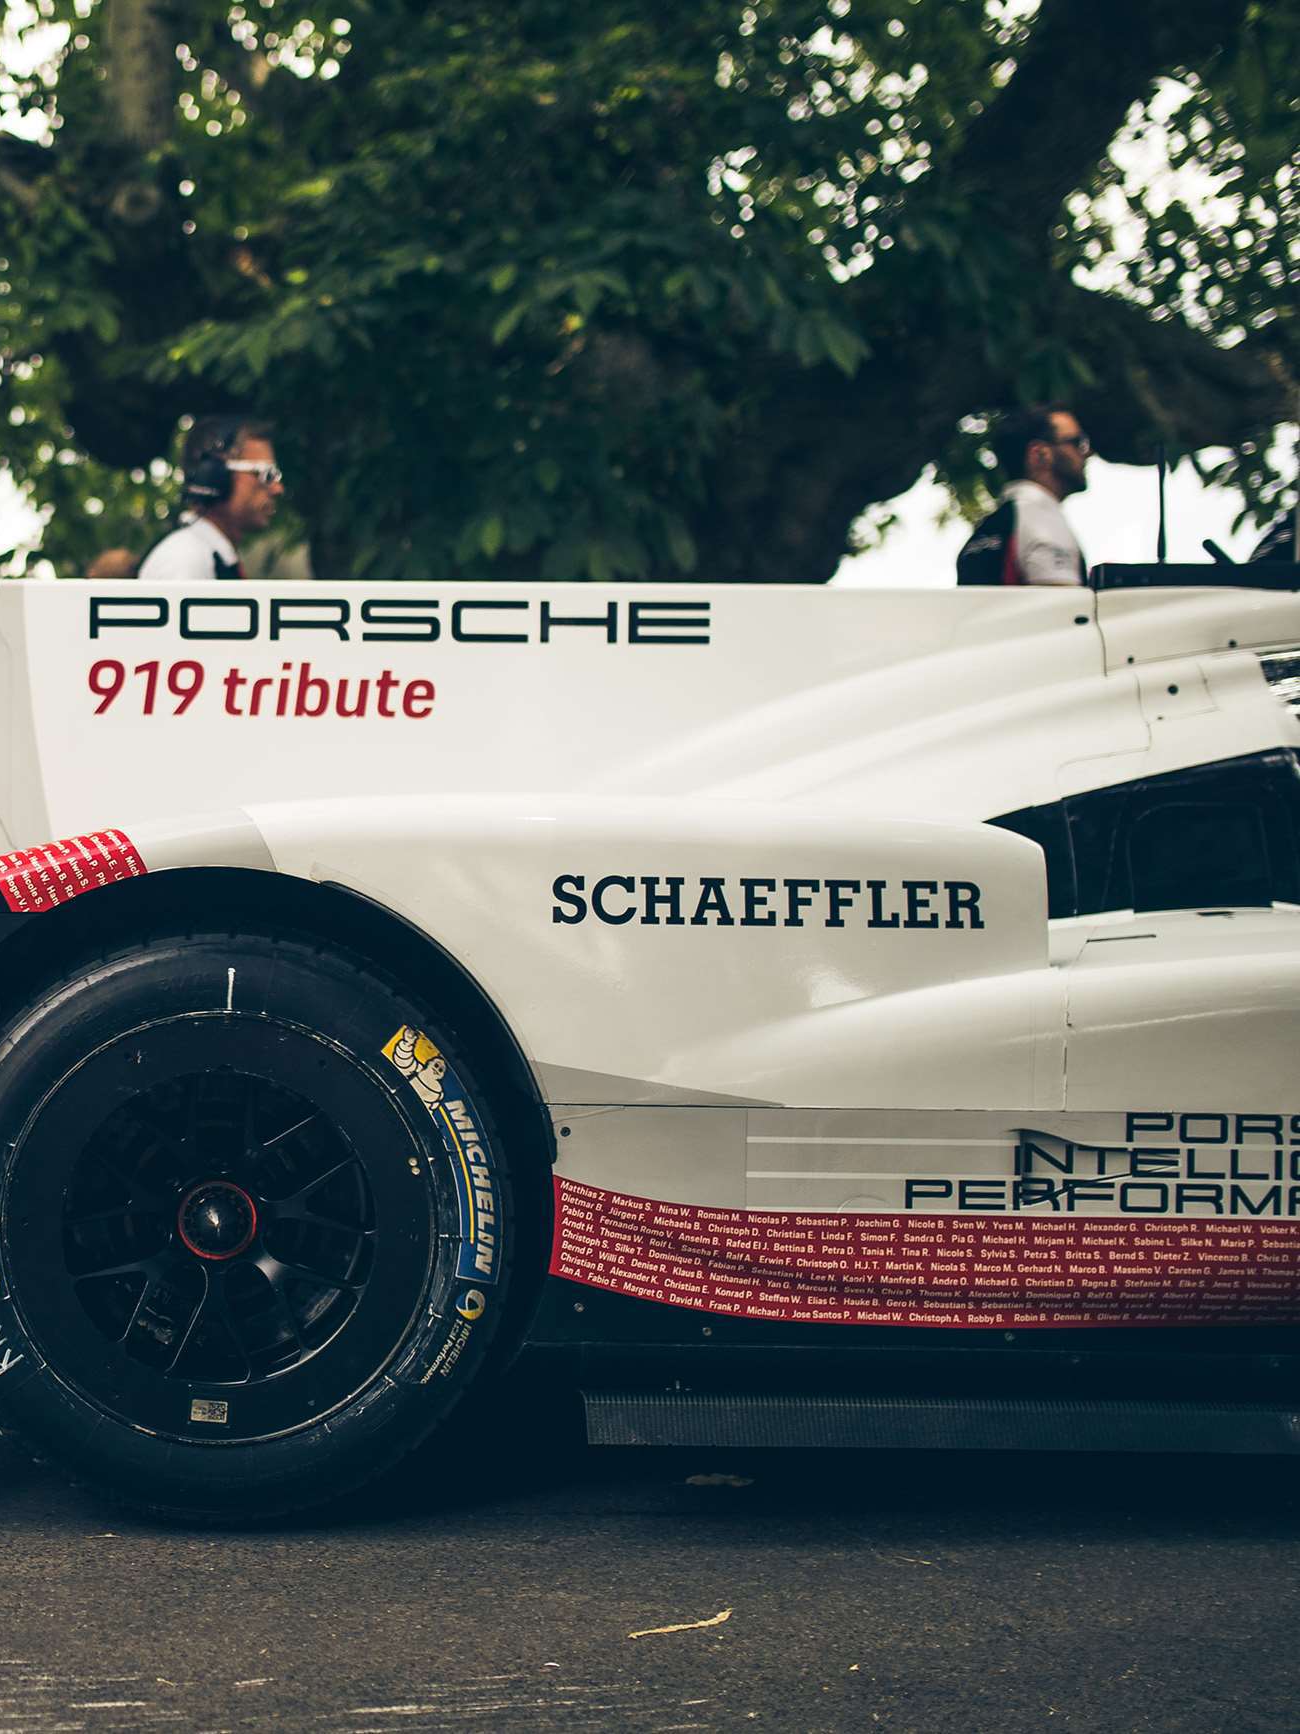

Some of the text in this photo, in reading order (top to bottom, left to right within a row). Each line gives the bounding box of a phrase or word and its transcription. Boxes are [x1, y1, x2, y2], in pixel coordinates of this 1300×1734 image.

[89, 596, 711, 645] PORSCHE
[88, 659, 435, 719] 919 tribute
[21, 870, 38, 897] Nicole
[35, 897, 43, 907] S.
[40, 872, 50, 885] W.
[59, 873, 67, 884] B.
[80, 878, 88, 888] S.
[89, 860, 98, 870] P.
[108, 860, 117, 870] E.
[5, 874, 27, 908] Roger V.
[552, 874, 985, 930] SCHAEFFLER
[1125, 1112, 1300, 1145] POR
[1014, 1143, 1300, 1181] INTELLI
[444, 1099, 495, 1275] MICHELIN
[560, 1180, 987, 1229] Matthias Z. Markus S. Nina W. Romain M. Nicolas P. Sébastien P. Joachim G. Nicole B. Sven W.
[905, 1179, 1300, 1216] PERFORM
[561, 1192, 945, 1243] Dietmar B. Jürgen F. Michaela B. Christoph D. Christian E. Linda F. Simon F. Sandra G.
[561, 1204, 930, 1256] Pablo D. Anselm B. Rafed El J. Bettina B. Petra D. Tania H. Tina R.
[561, 1217, 969, 1271] Arndt H. Thomas W. Christoph O. H.J. T. Martin K. Nicola S.
[561, 1240, 760, 1286] Bernd P. Willi G. Denise R. Klaus B. Nathanael H.
[562, 1228, 600, 1246] Christoph
[601, 1239, 610, 1249] S.
[614, 1242, 635, 1254] Silke
[636, 1246, 643, 1255] T.
[694, 1257, 702, 1265] D.
[932, 1276, 958, 1285] Andre
[959, 1277, 968, 1285] O.
[560, 1252, 802, 1303] Christian B. Alexander K. Christian E. Konrad P. Steffen W.
[587, 1272, 851, 1319] Fabio E. Margret G. David M. Frank P. Michael J. Jose Santos P.
[440, 1323, 472, 1376] MICHELIN
